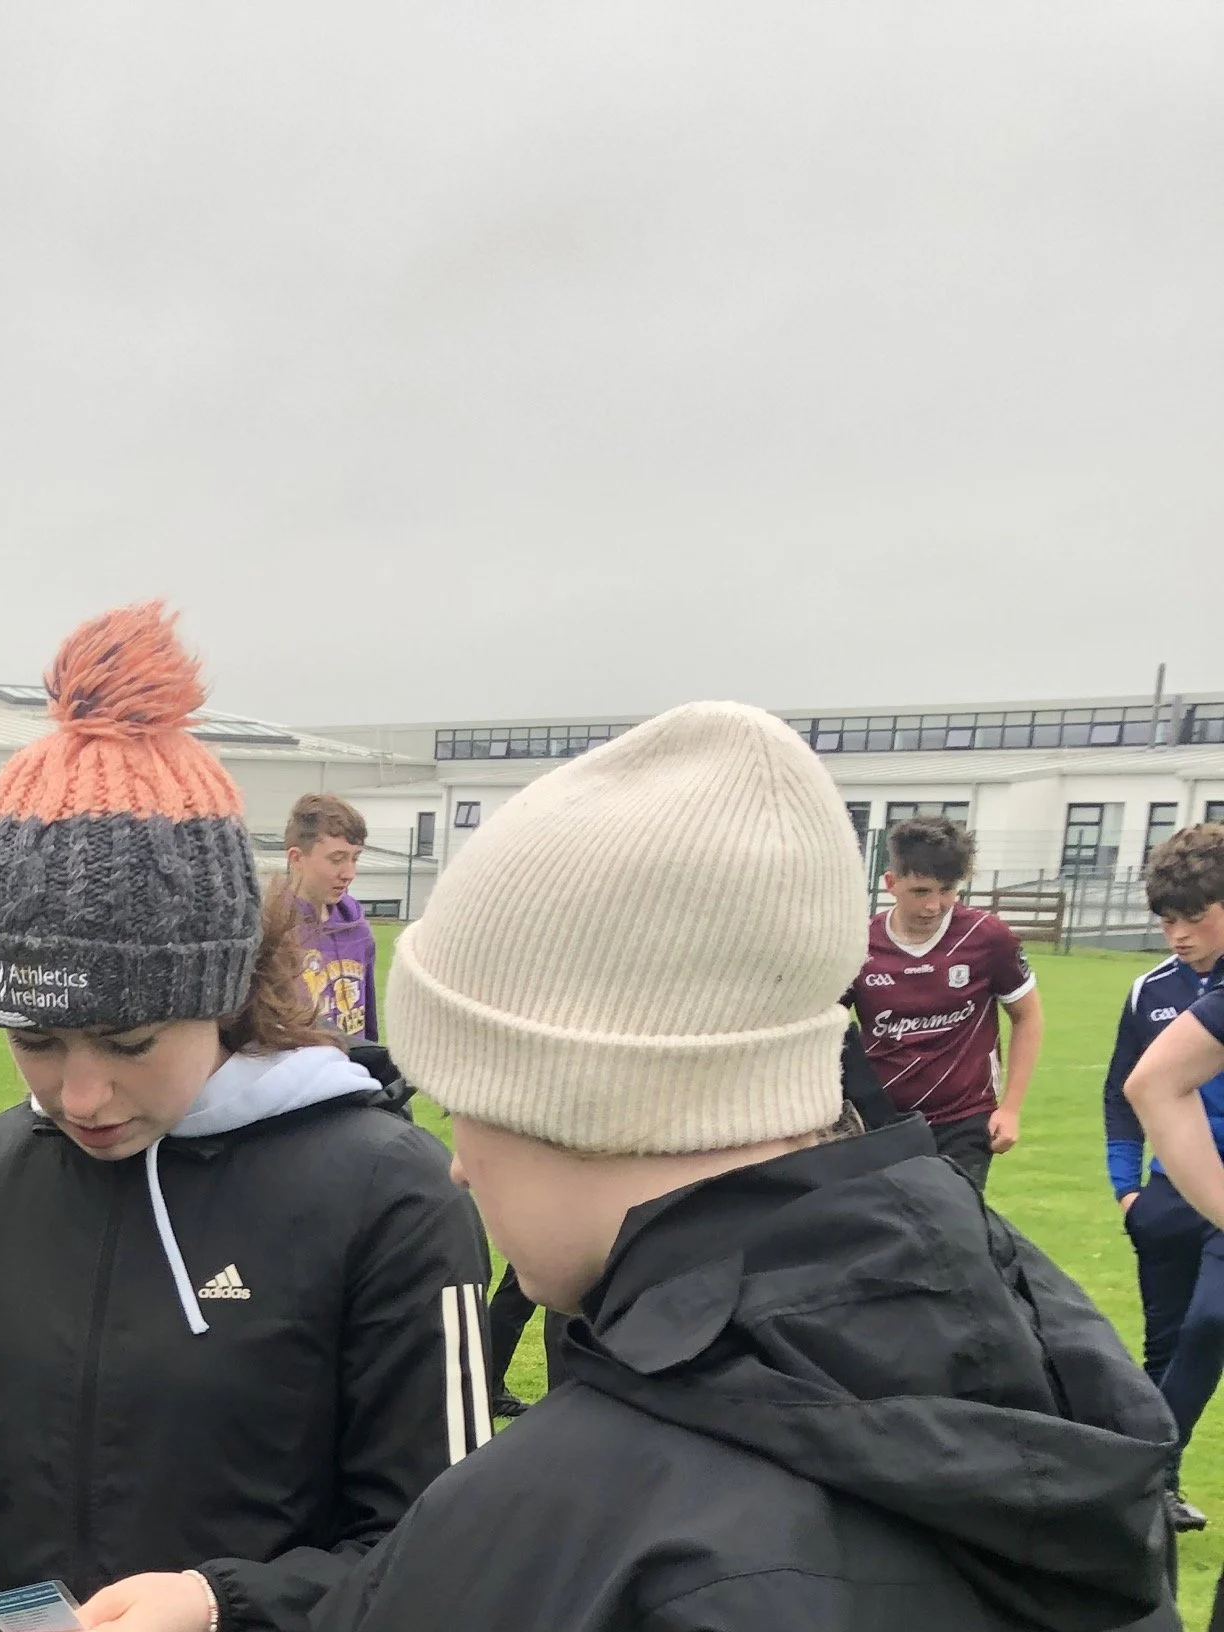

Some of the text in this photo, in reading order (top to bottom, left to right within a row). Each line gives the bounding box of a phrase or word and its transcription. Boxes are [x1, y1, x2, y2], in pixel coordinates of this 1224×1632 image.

[9, 963, 88, 988] Athletics
[865, 973, 896, 987] GAA
[10, 986, 69, 1009] Ireland
[197, 1285, 252, 1300] adidas
